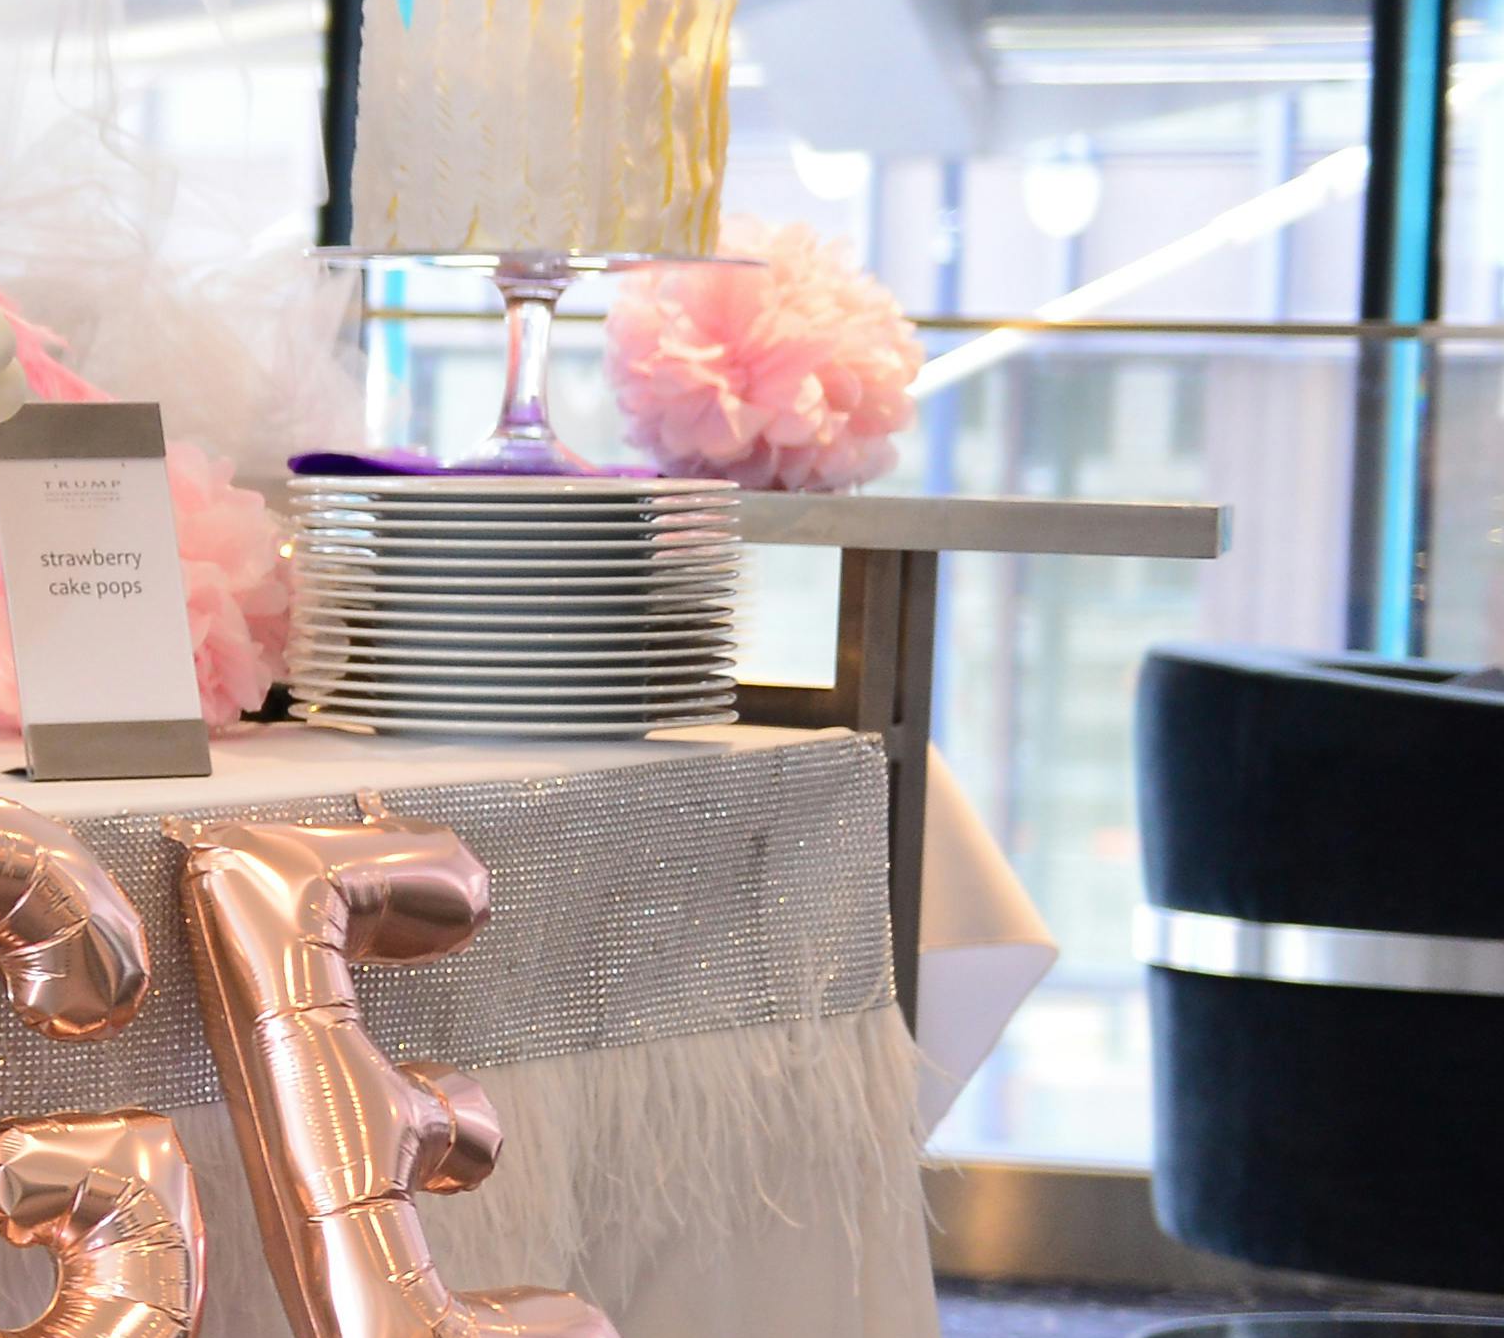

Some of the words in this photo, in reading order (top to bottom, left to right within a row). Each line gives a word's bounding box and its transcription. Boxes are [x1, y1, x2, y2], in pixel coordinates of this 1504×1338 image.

[44, 480, 121, 489] TRUMP
[40, 549, 142, 570] strawberry
[49, 578, 91, 596] cake
[97, 580, 143, 599] pops
